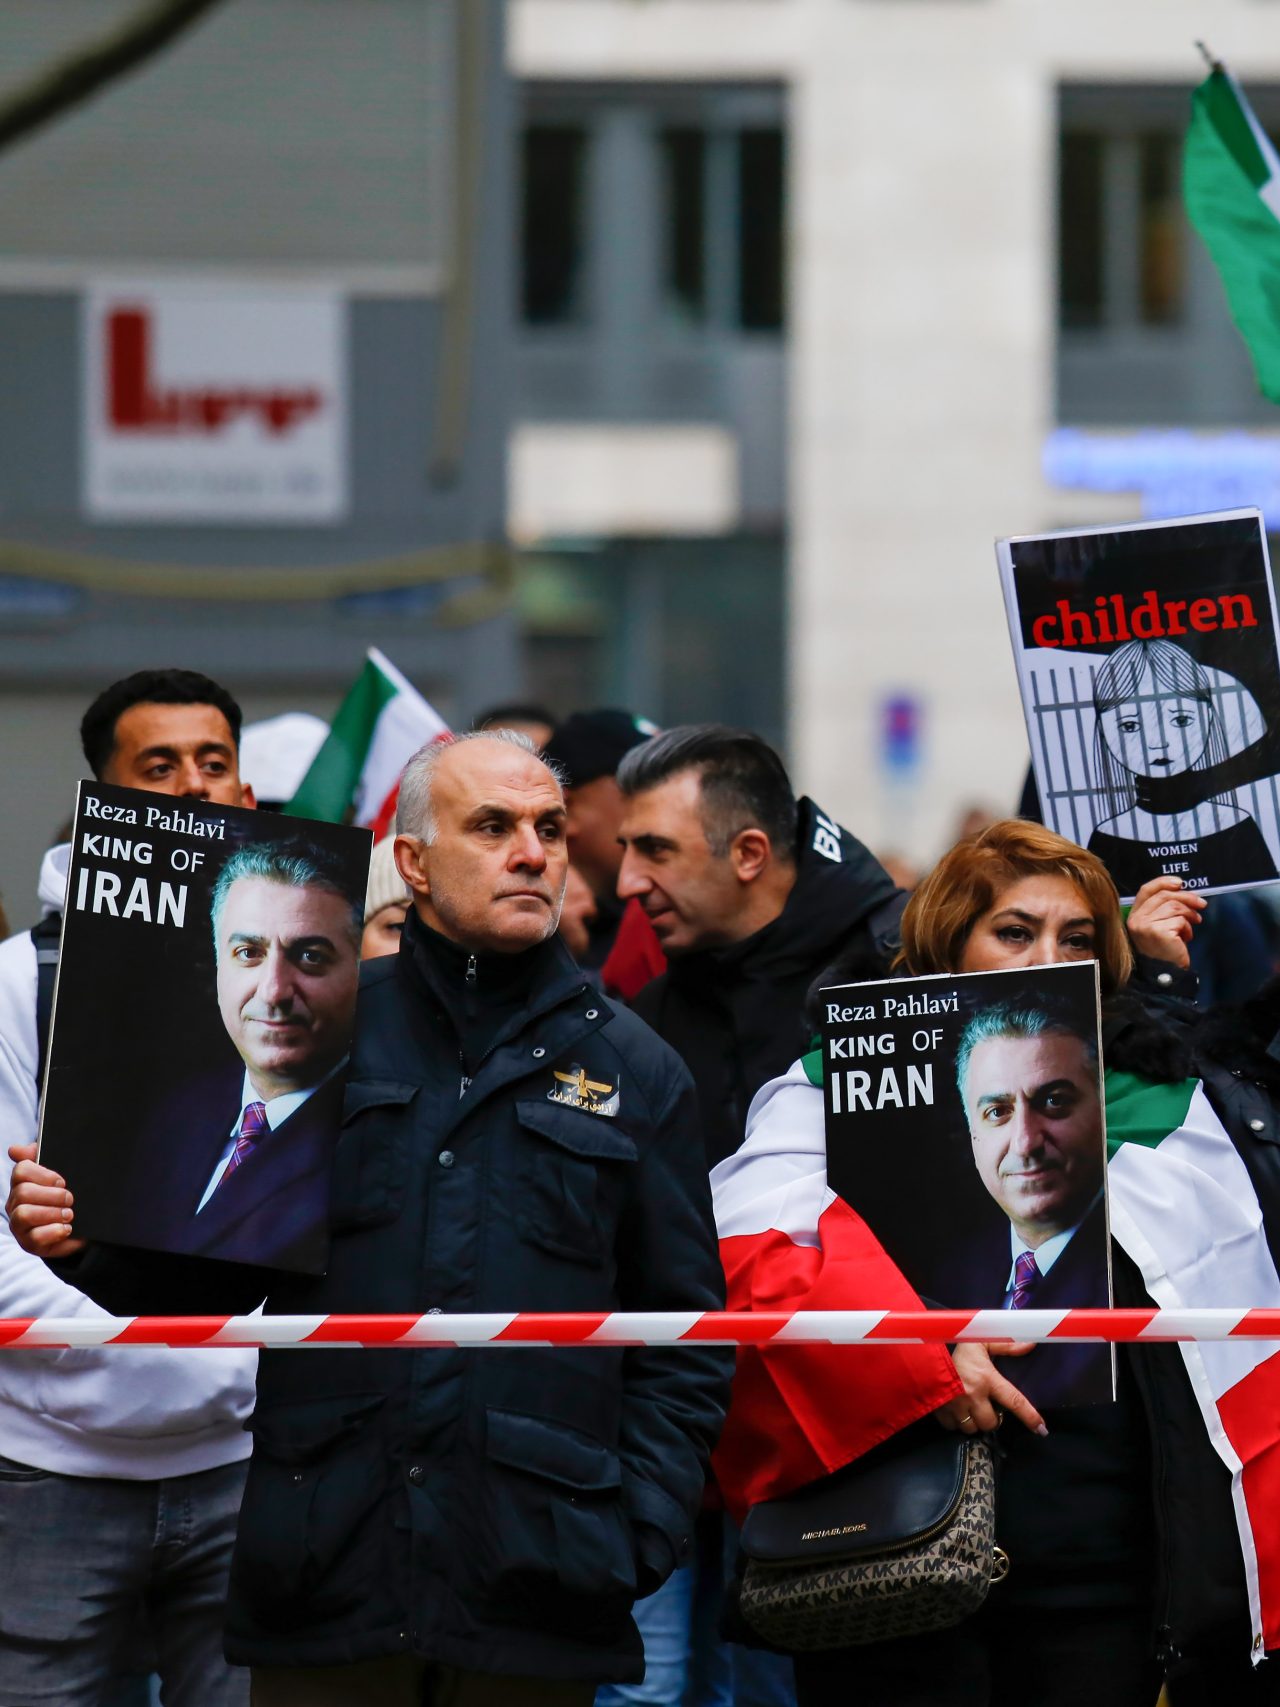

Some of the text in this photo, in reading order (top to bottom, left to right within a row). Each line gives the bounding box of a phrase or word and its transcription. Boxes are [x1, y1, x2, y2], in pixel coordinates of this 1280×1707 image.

[1032, 590, 1258, 648] children
[83, 796, 226, 841] Reza Pahlavi
[82, 832, 206, 873] KING OF
[1147, 843, 1199, 858] WOMEN
[1161, 861, 1190, 875] LIFE
[76, 867, 189, 928] IRAN
[826, 991, 960, 1024] Reza Pahlavi
[829, 1028, 944, 1059] KING OF
[831, 1063, 934, 1114] IRAN
[801, 1522, 868, 1541] MICHAEL KORS
